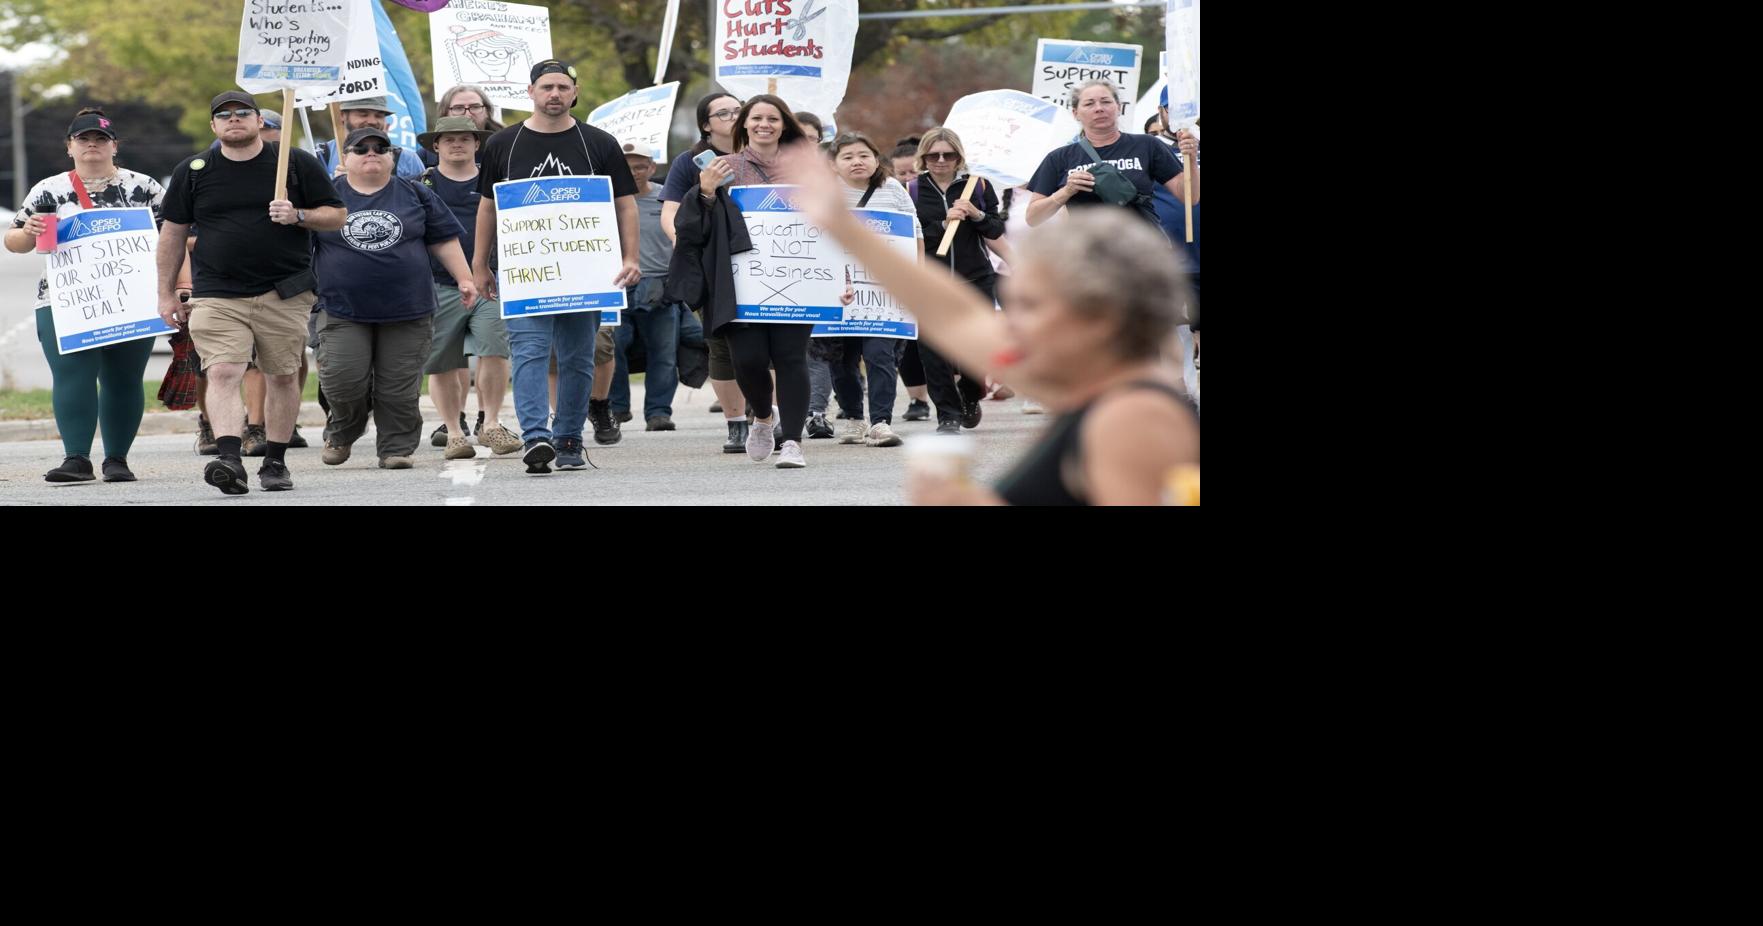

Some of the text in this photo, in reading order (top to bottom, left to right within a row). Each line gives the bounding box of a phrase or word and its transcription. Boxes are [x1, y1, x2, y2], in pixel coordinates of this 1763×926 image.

[724, 0, 792, 18] Cuts
[250, 16, 300, 30] Who's
[727, 18, 787, 38] Hurt
[258, 30, 330, 52] Supporting
[723, 39, 824, 60] Students
[347, 58, 381, 70] NDING
[1043, 66, 1128, 84] SUPPORT
[339, 78, 378, 95] FORD!
[91, 218, 121, 227] OPSEU
[91, 224, 121, 233] SEFPO
[502, 214, 600, 234] SUPPORT STAFF
[744, 216, 823, 238] ducation
[503, 238, 612, 258] HELP STUDENTS
[772, 240, 816, 255] NOT
[56, 259, 140, 288] OUR JOBS.
[503, 262, 562, 285] THRIVE!
[750, 260, 836, 281] Business.
